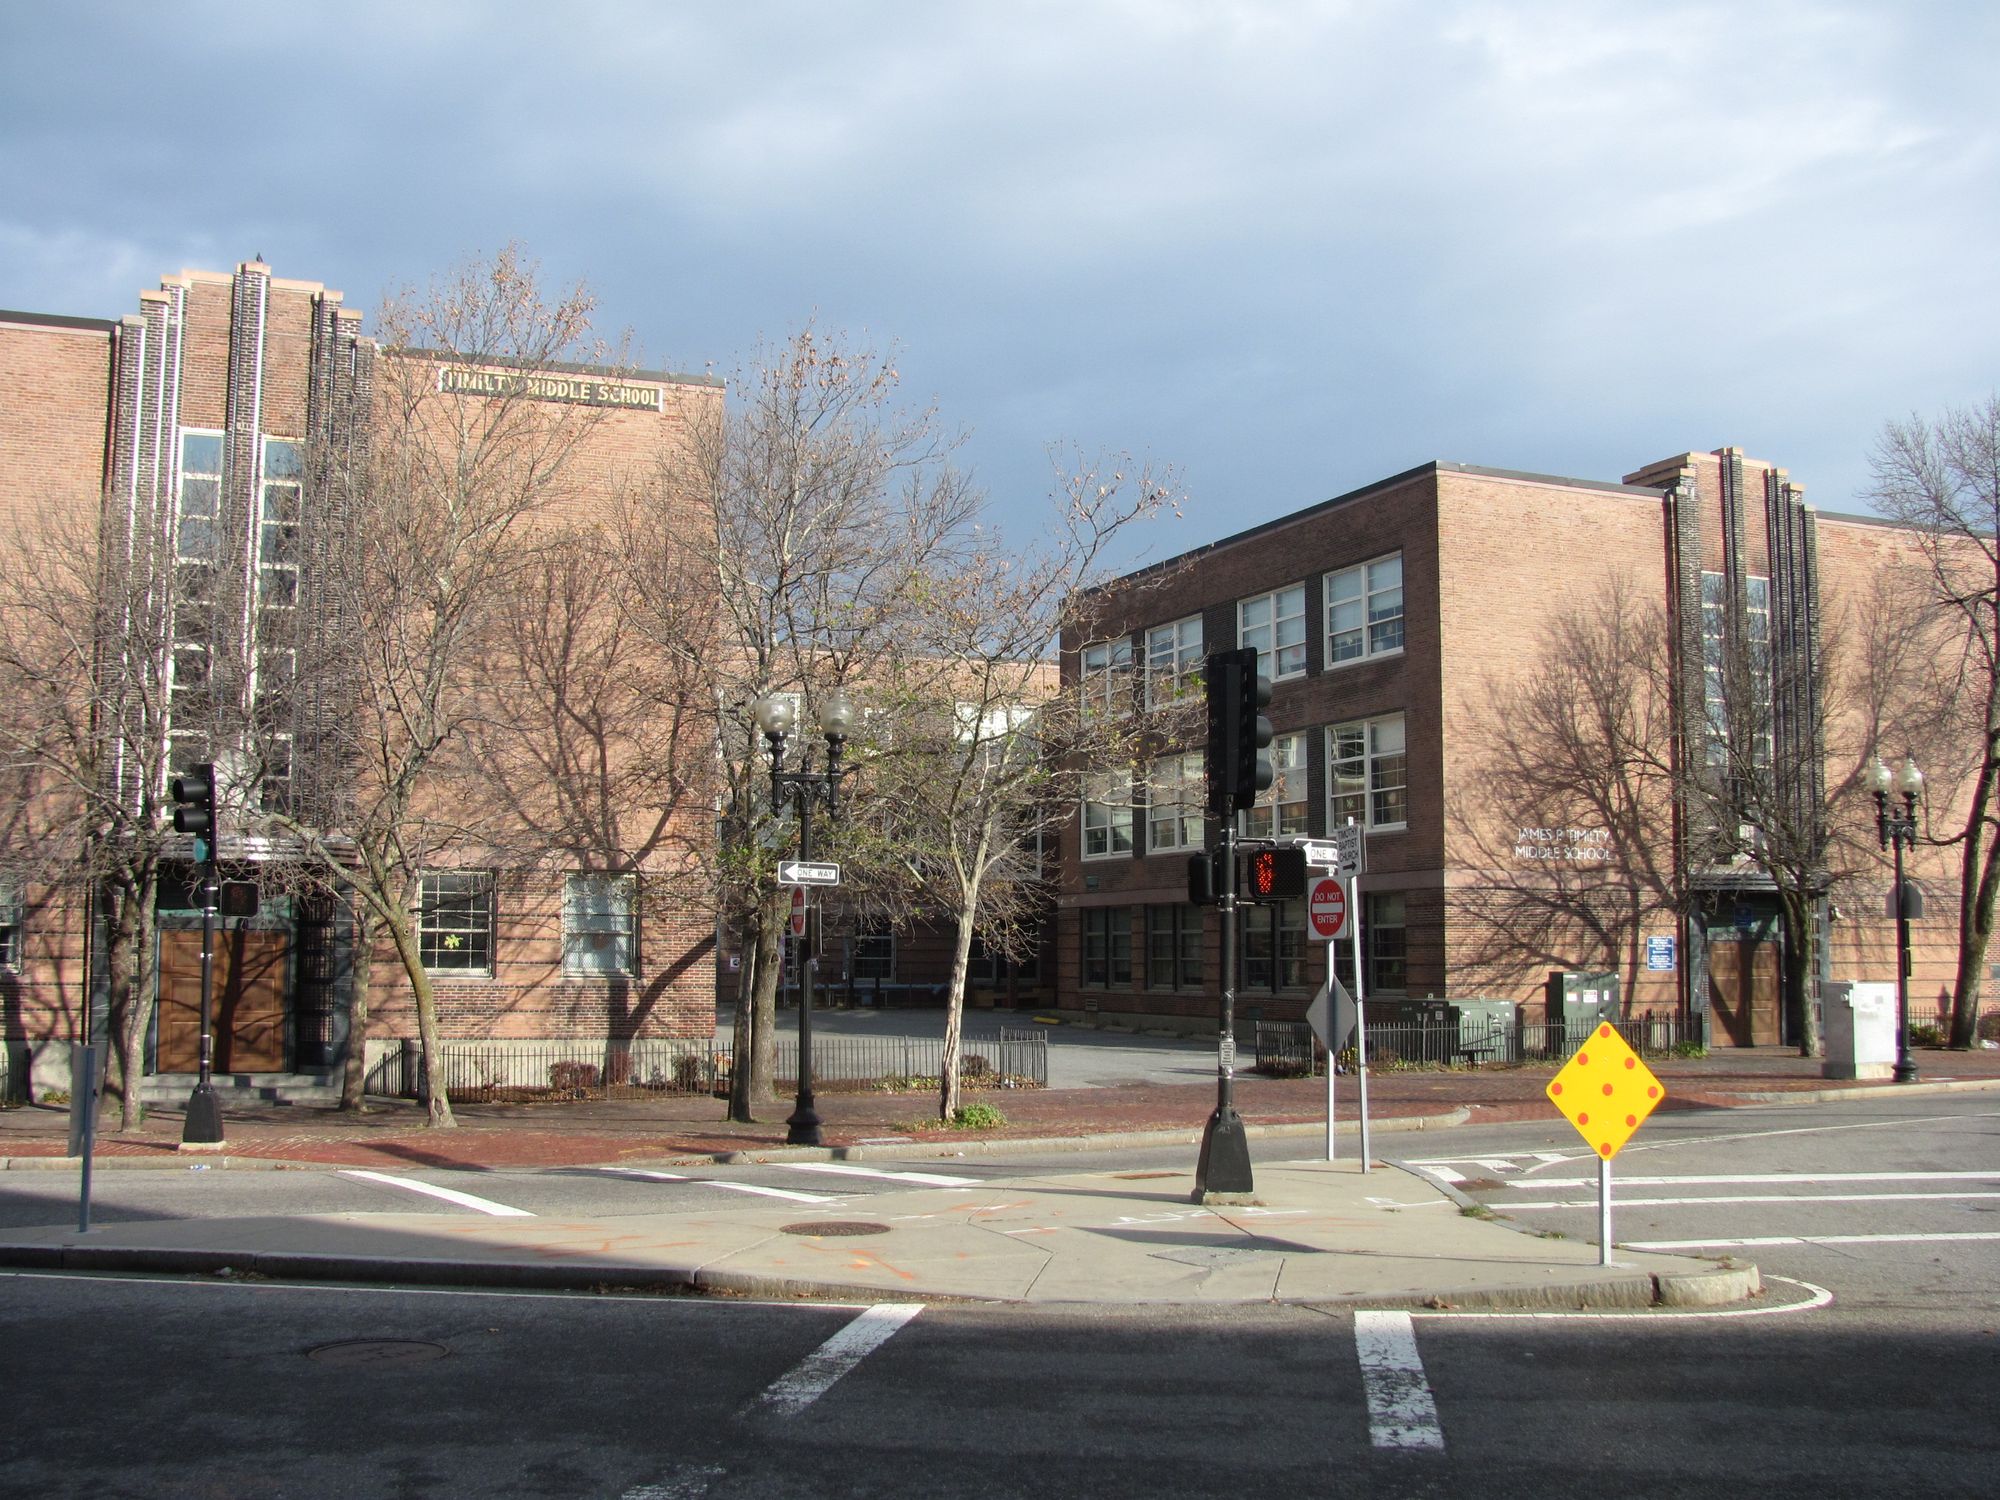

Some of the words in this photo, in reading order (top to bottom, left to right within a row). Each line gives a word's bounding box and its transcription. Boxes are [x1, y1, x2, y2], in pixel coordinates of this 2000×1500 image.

[526, 379, 590, 400] MIDDLE
[597, 384, 660, 406] SCHOOL
[1517, 828, 1552, 843] JAMES
[1311, 847, 1327, 859] ONE
[1515, 846, 1560, 859] MIDDLE
[1564, 847, 1614, 860] SCHOOL
[798, 868, 813, 877] ONE
[818, 870, 833, 878] WAY
[1315, 893, 1325, 902] DO
[1327, 892, 1340, 901] NOT
[1317, 914, 1338, 924] ENTER
